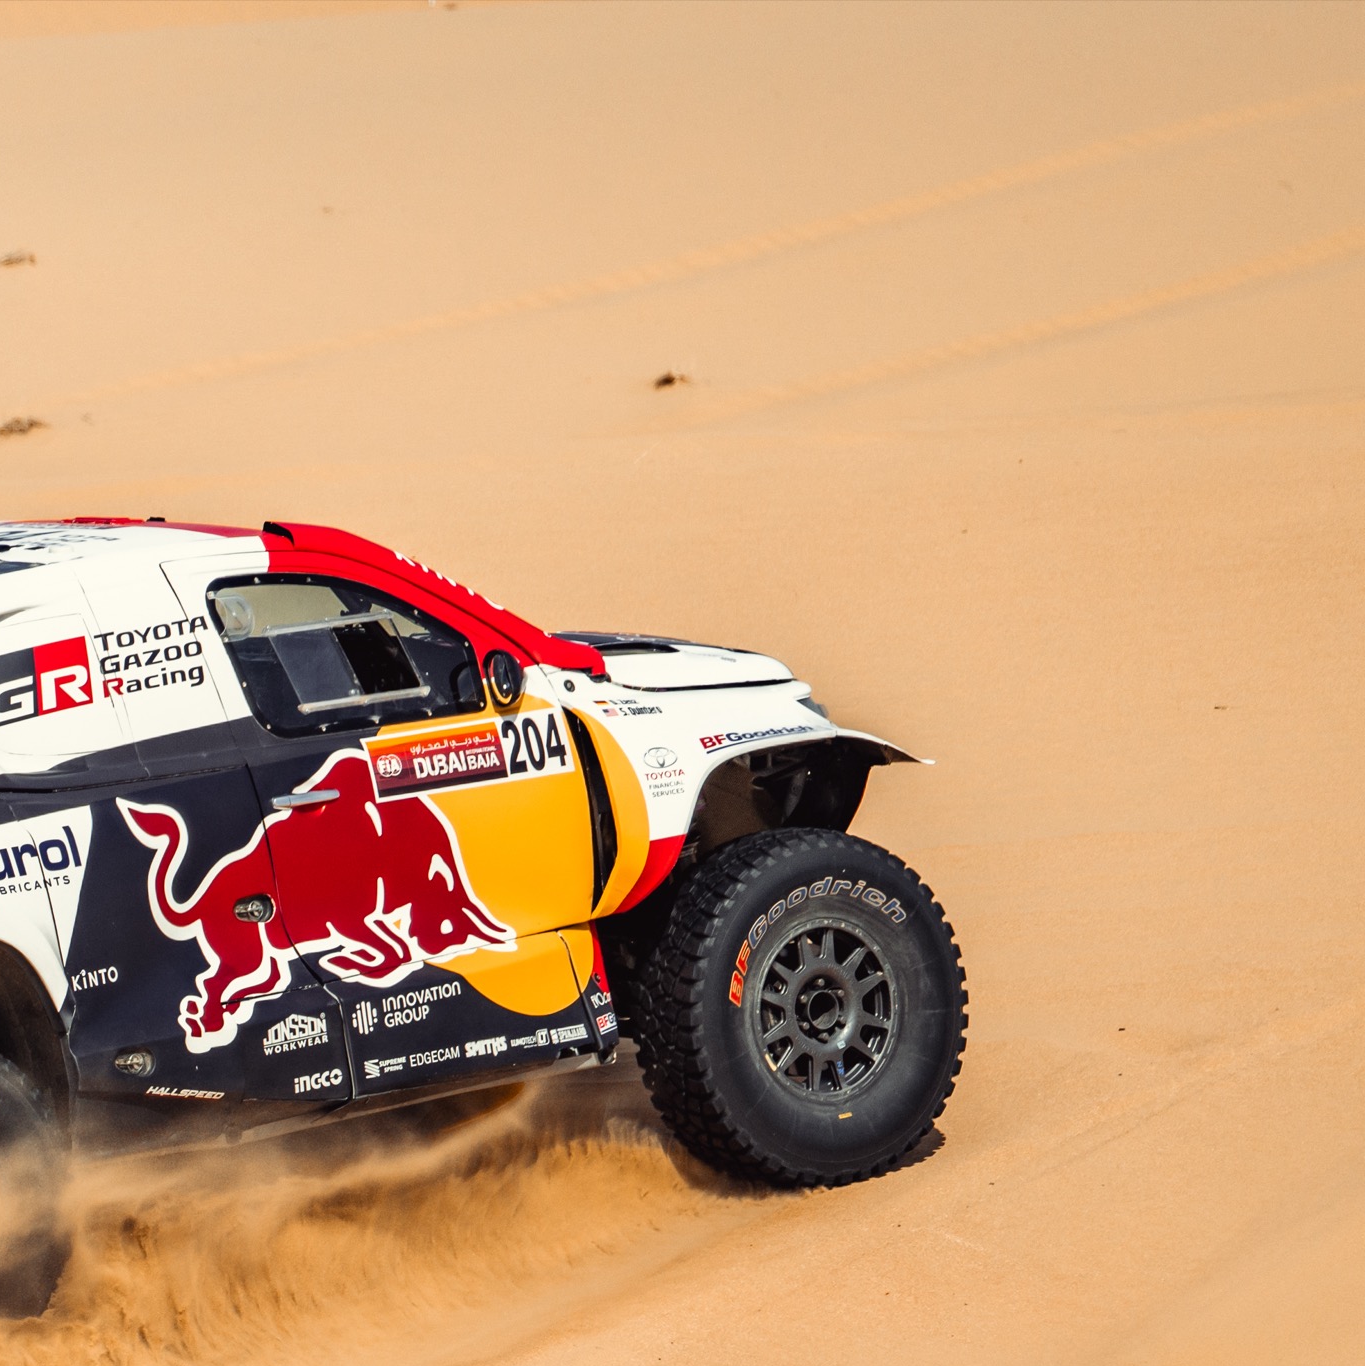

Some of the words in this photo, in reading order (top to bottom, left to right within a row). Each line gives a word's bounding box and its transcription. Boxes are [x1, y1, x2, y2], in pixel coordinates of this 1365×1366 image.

[94, 615, 209, 652] TOYOTA
[99, 640, 204, 675] GAZOO
[103, 665, 205, 699] Racing
[501, 713, 568, 775] 204
[699, 725, 814, 750] BFGoodrich
[378, 756, 401, 775] FIA
[413, 750, 467, 779] DUBAI
[467, 752, 500, 769] BAJA
[645, 768, 685, 781] TOYOTA
[649, 780, 684, 789] FINANCIAL
[652, 788, 685, 798] SERVICES
[729, 876, 907, 1008] BFGoodrich
[384, 1004, 430, 1028] GROUP
[263, 1034, 329, 1056] WORKWEAR
[464, 1035, 507, 1058] SMITHS
[379, 1056, 407, 1068] SUPREME
[409, 1046, 461, 1068] EDGECAM
[383, 1064, 403, 1074] SPRING
[146, 1085, 225, 1100] HALLSPEED
